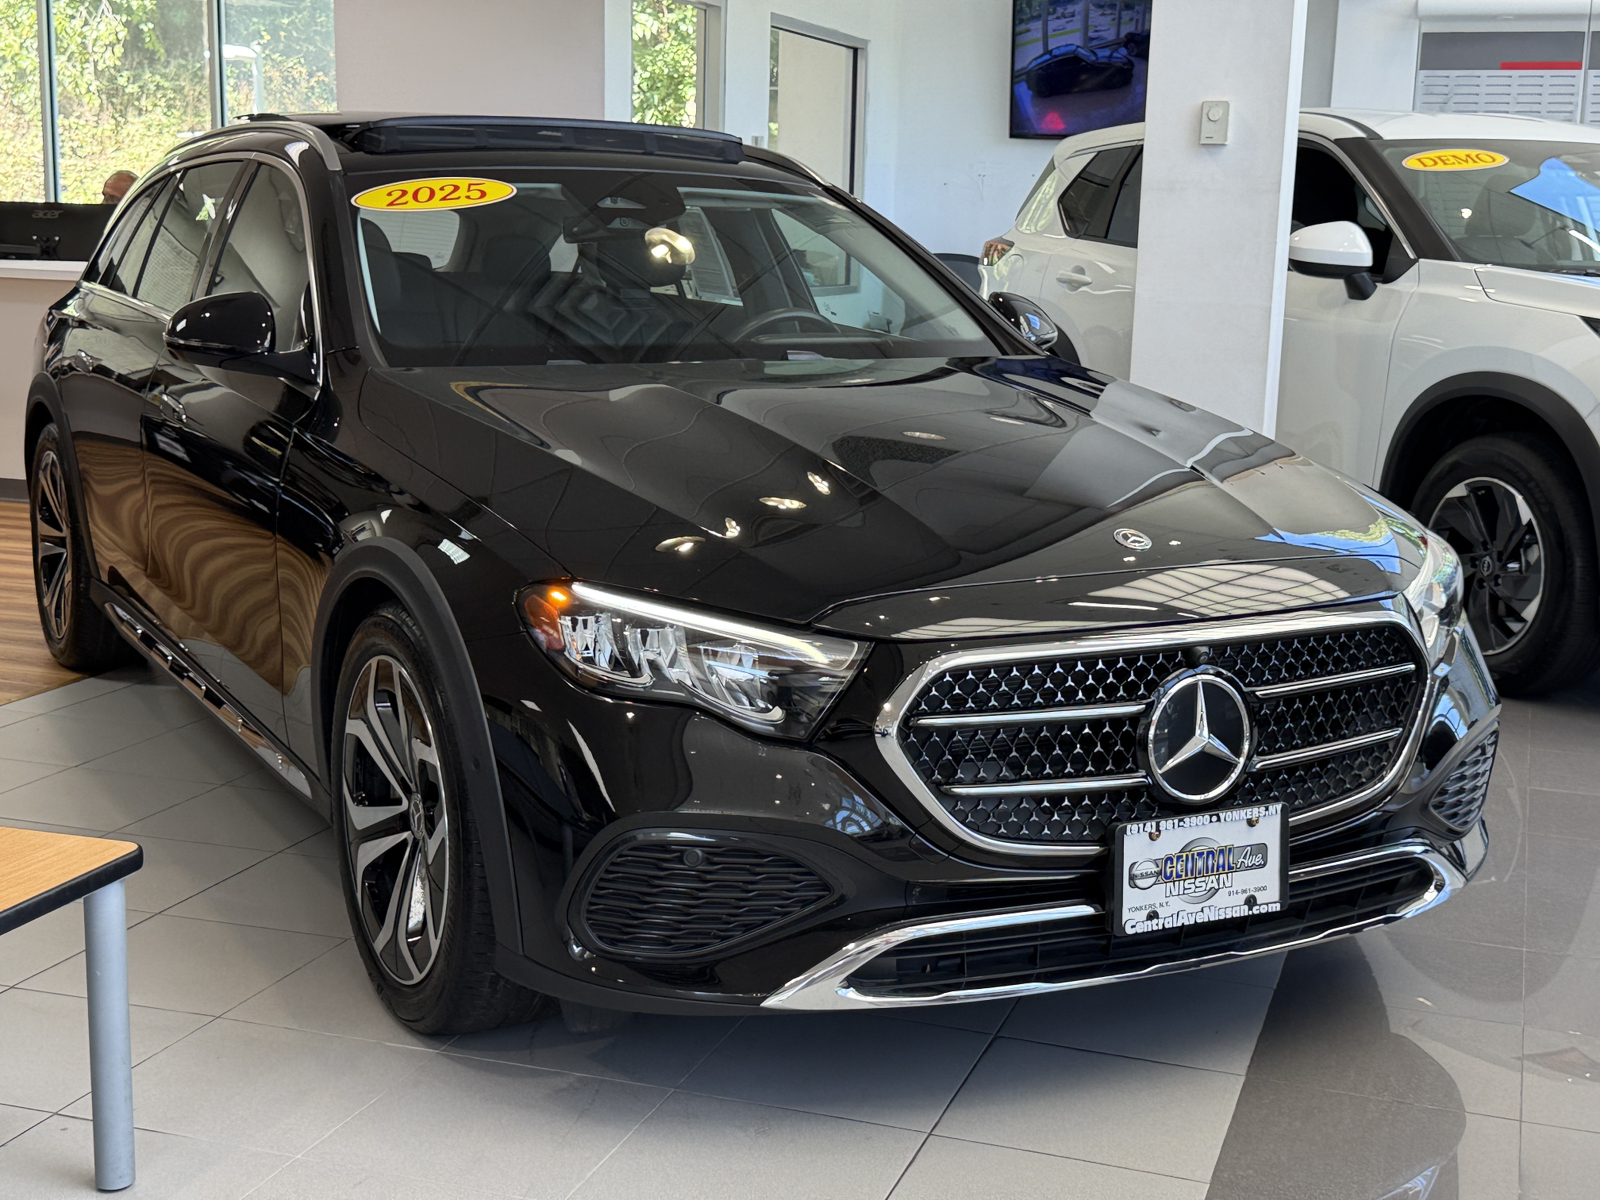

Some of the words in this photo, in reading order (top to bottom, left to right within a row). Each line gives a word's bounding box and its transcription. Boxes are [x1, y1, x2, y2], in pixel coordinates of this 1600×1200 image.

[1416, 152, 1496, 168] DEMO
[386, 182, 487, 207] 2025
[32, 209, 64, 219] acer
[1132, 870, 1159, 878] NISSAN
[1162, 844, 1236, 883] CENTRAL
[1236, 846, 1265, 869] Ave.
[1165, 872, 1233, 898] NISSAN
[1124, 902, 1281, 935] CentralAveNissan.com
